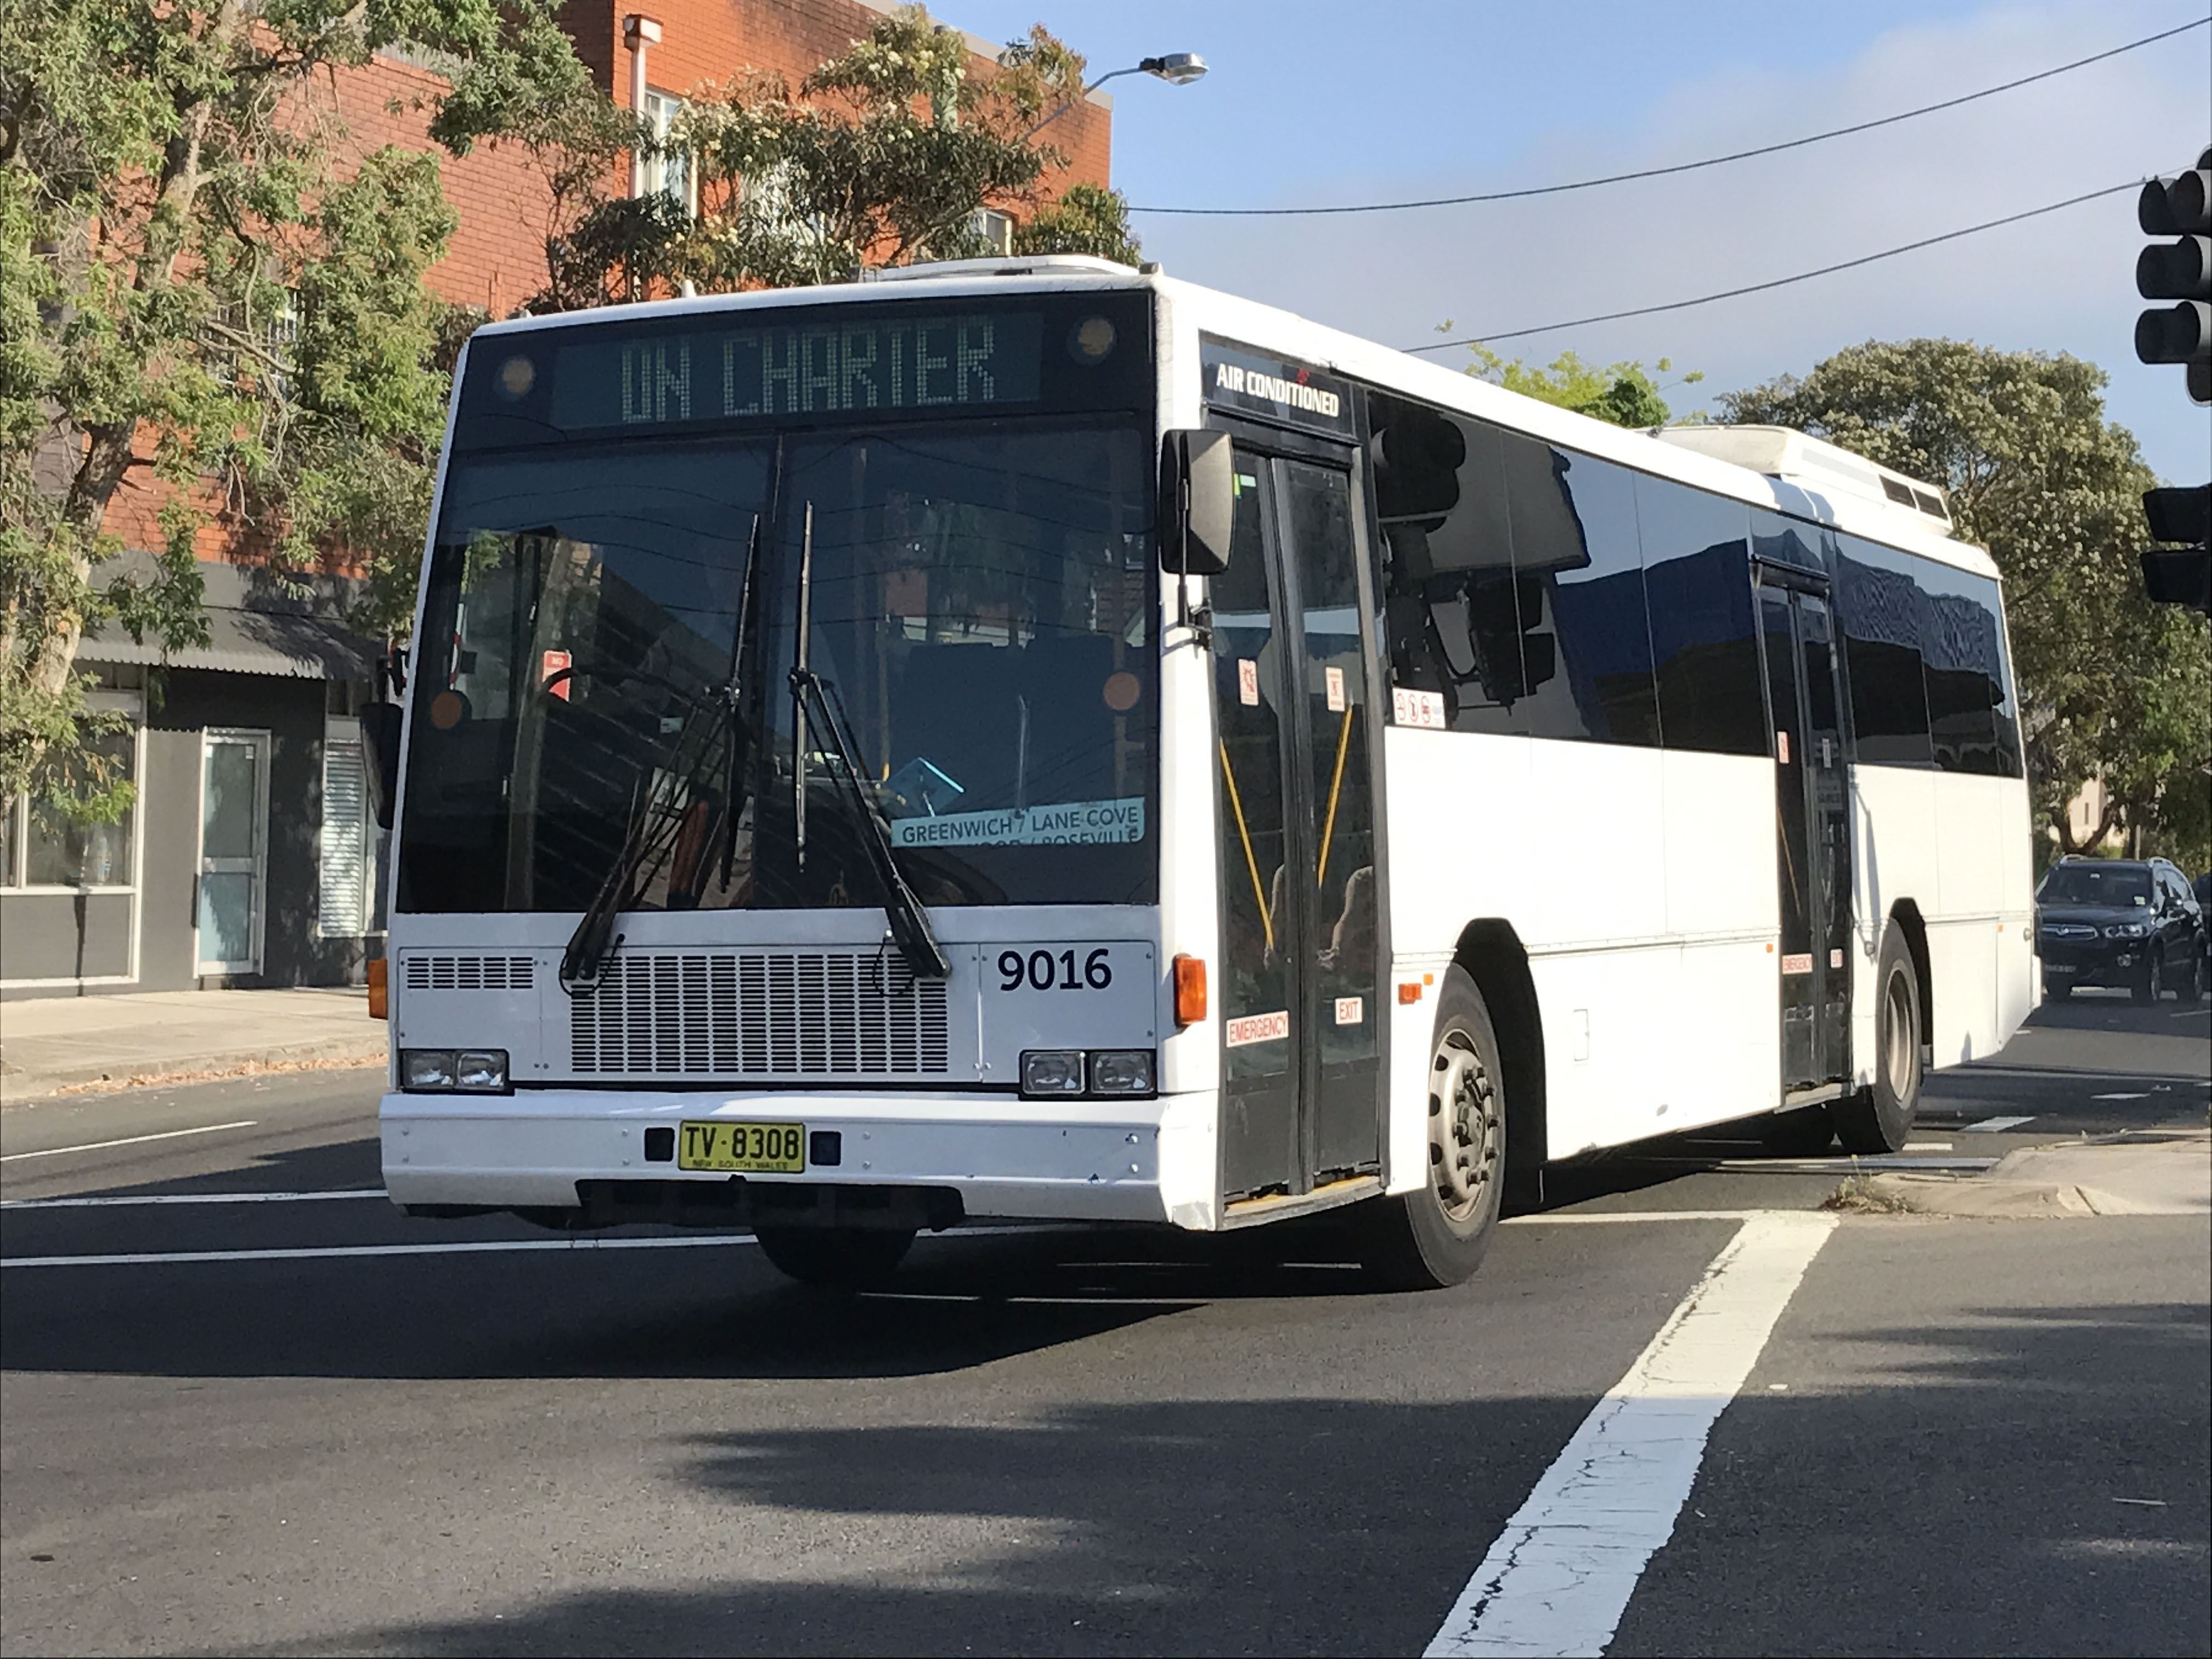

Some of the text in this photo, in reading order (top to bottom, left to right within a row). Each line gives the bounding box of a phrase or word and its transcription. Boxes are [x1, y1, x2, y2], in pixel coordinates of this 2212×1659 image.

[723, 316, 995, 416] CHARTER
[1216, 363, 1339, 417] AIR CONDITIONED
[902, 816, 1012, 843] GREENWICH
[1032, 811, 1081, 832] LANE
[1087, 806, 1138, 827] COVE
[997, 948, 1112, 991] 9016
[1229, 1015, 1288, 1042] EMERGENCY
[1339, 1001, 1359, 1021] EXIT
